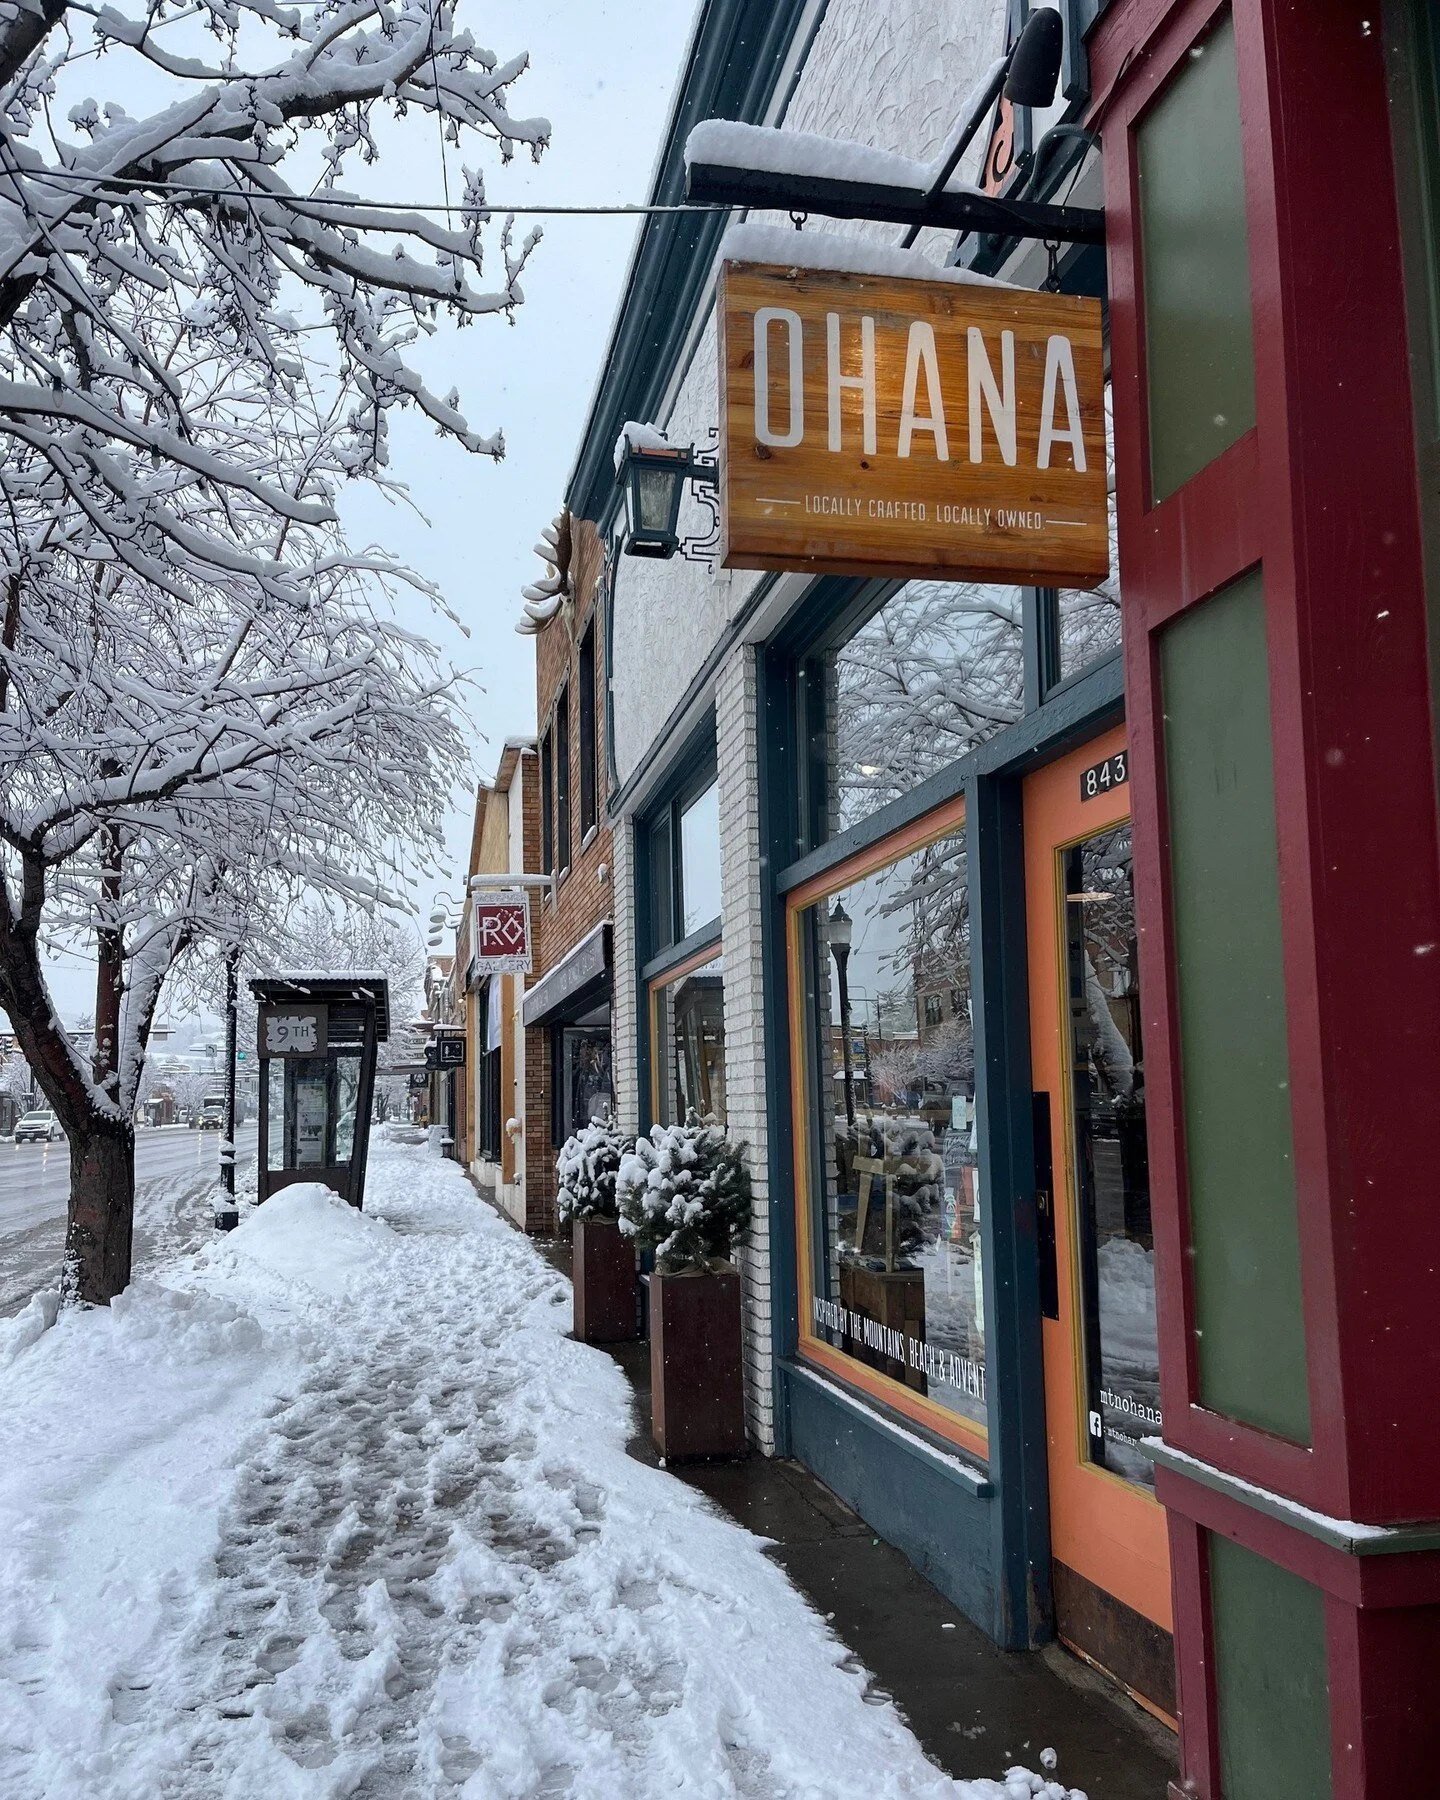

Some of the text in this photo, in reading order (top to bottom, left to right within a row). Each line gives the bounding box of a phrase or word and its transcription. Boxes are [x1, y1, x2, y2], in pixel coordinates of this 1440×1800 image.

[754, 307, 1087, 473] OHANA
[805, 494, 862, 516] LOCALLY
[936, 504, 991, 526] LOCALLY
[1086, 754, 1126, 796] 843
[849, 1310, 862, 1342] THE
[909, 1336, 936, 1377] BEACH
[939, 1349, 946, 1382] &
[1099, 1387, 1163, 1426] mtnohana
